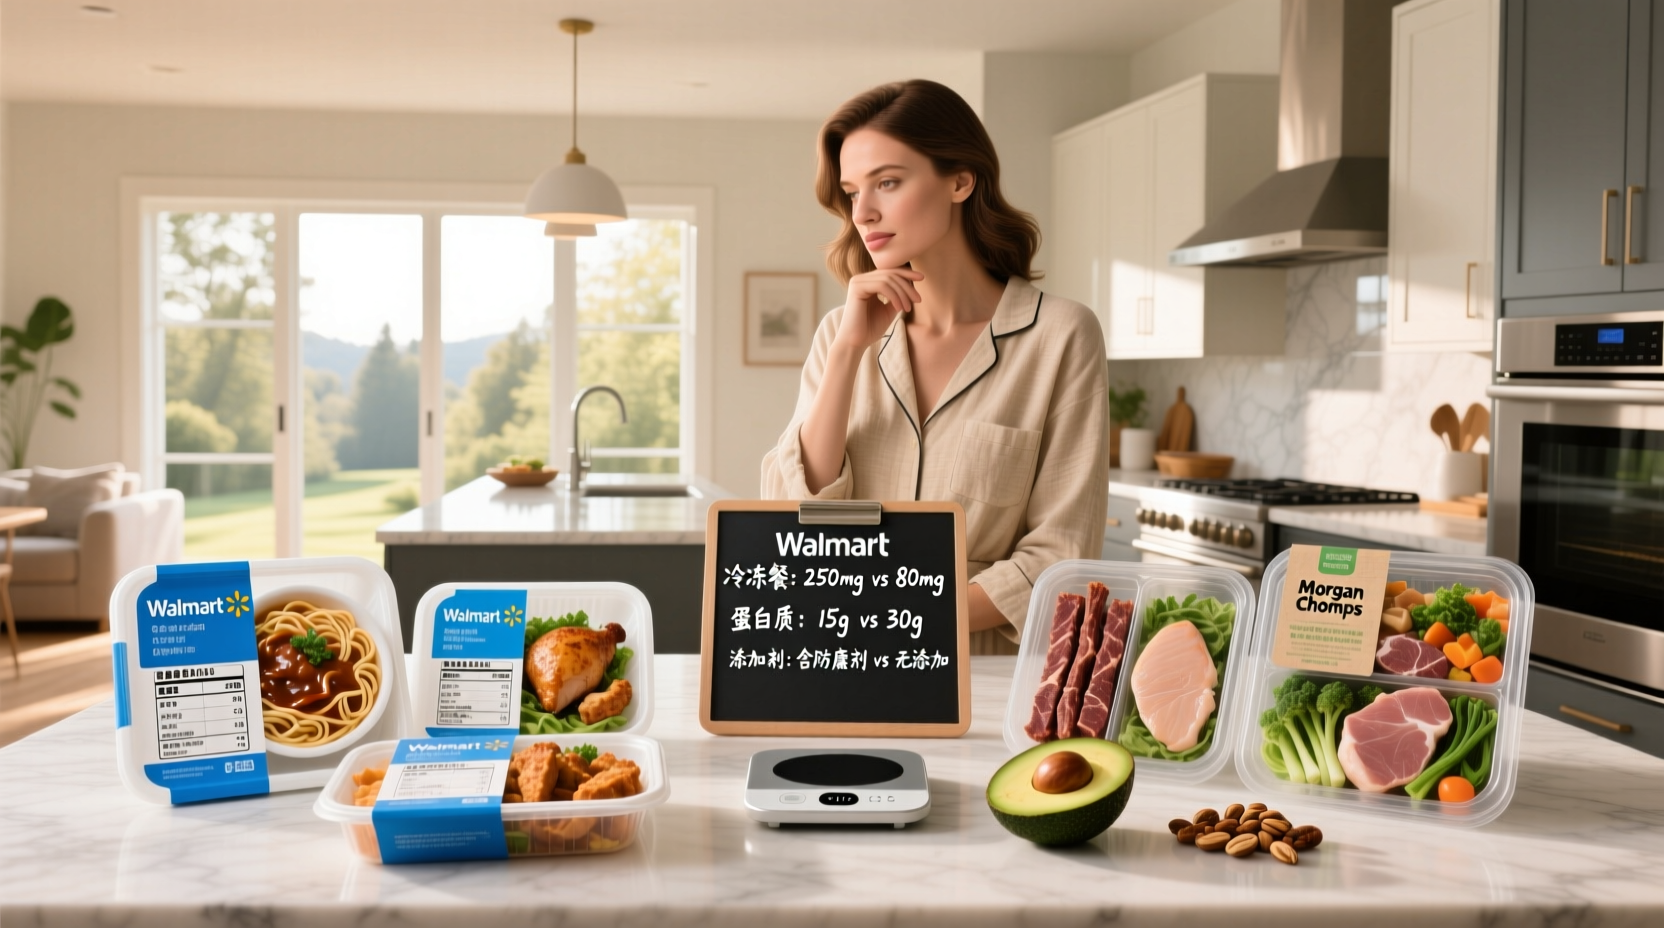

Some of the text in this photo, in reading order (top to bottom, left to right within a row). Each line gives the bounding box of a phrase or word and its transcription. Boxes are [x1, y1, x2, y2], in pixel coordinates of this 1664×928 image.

[776, 532, 890, 557] Walmart
[803, 567, 864, 597] 250mg
[872, 574, 889, 587] vs
[895, 566, 945, 597] 80mg
[1298, 579, 1364, 601] Morgan
[146, 597, 224, 617] Walmart
[443, 608, 500, 623] Walmart
[1296, 595, 1363, 620] Chomps
[730, 604, 923, 639] 蛋白质： 15g vs 30g
[873, 655, 890, 668] vs
[895, 648, 949, 670] 无添加
[408, 743, 481, 752] Walmart
